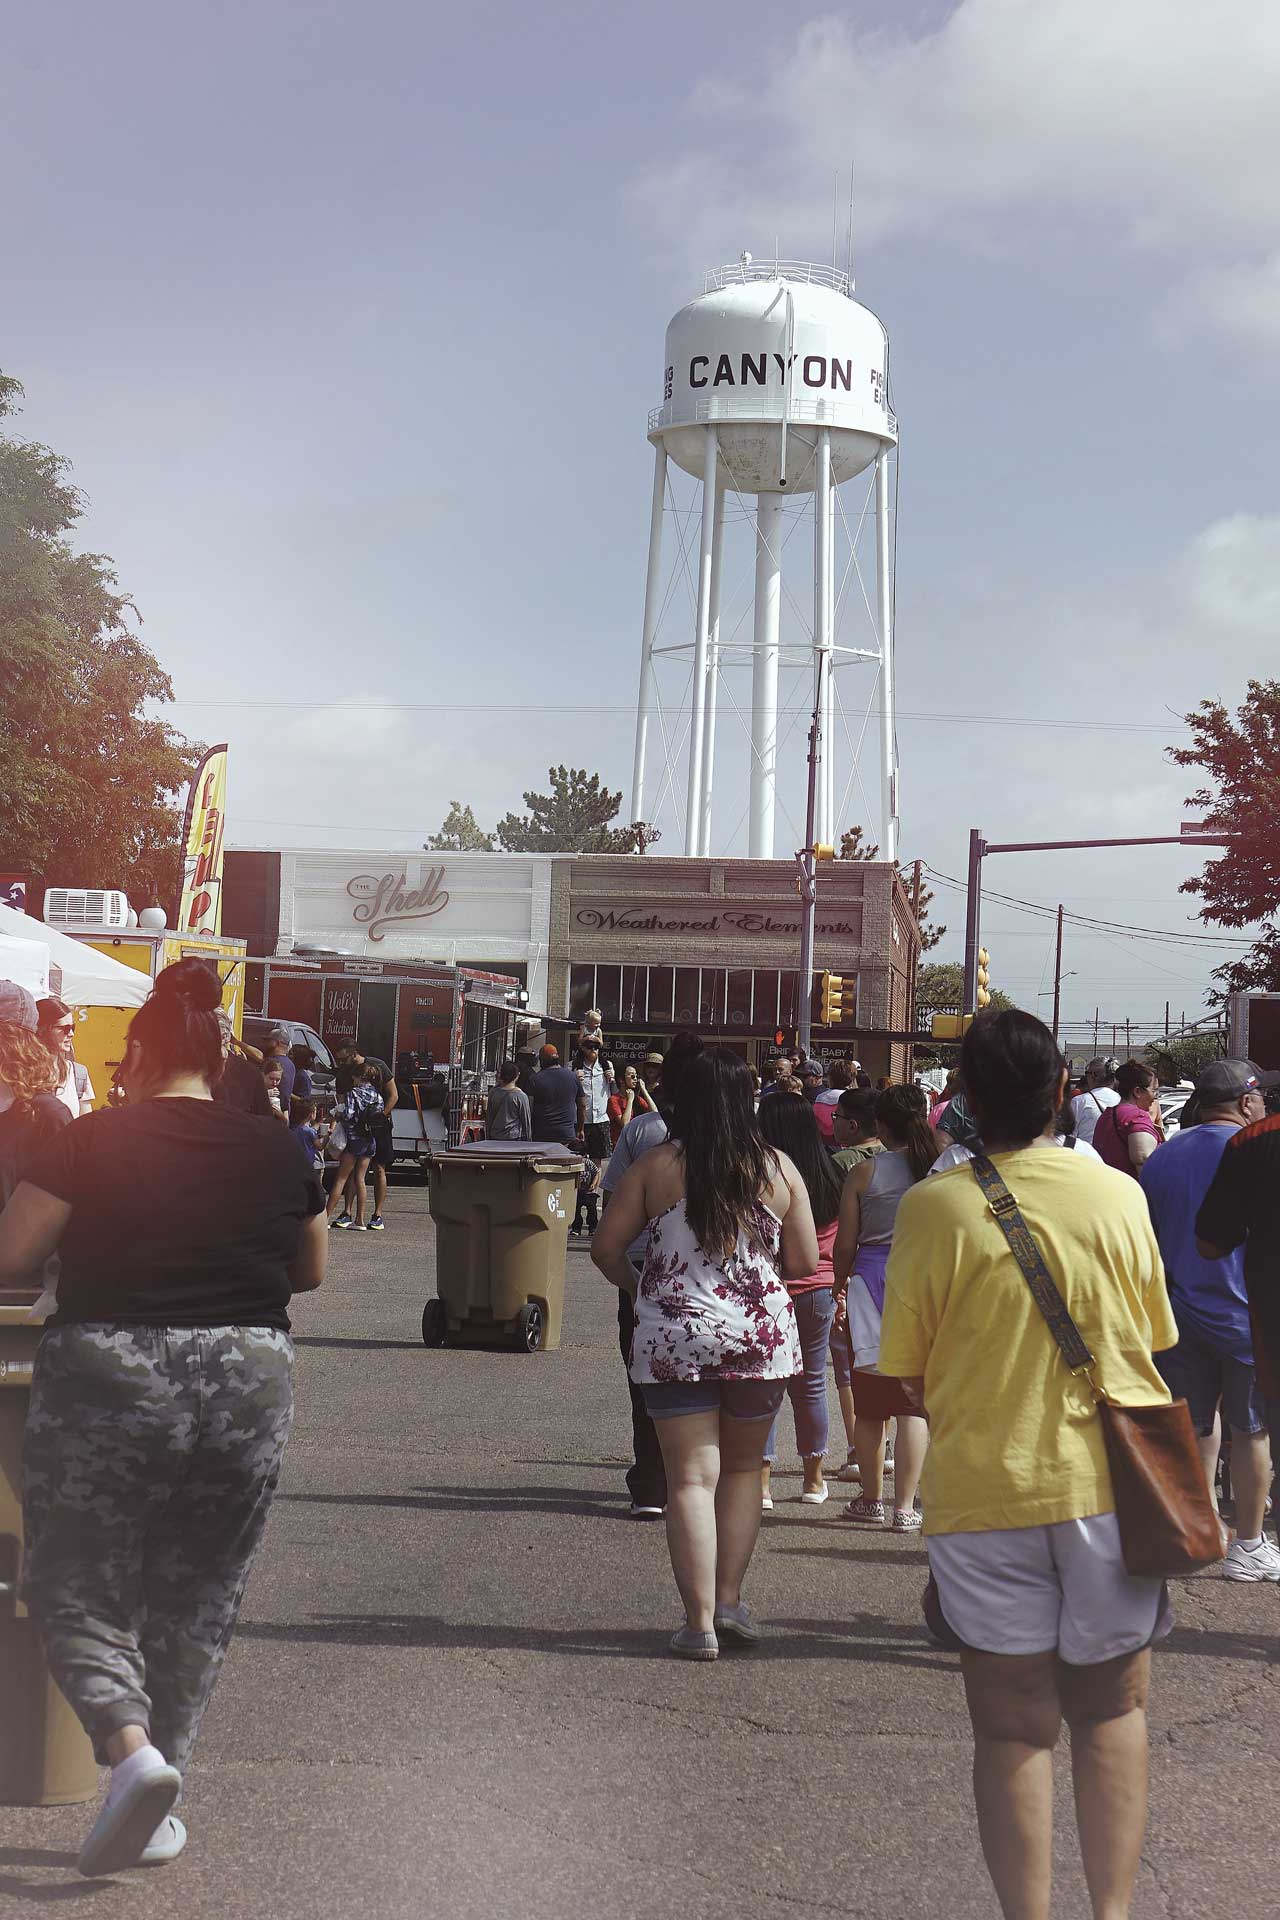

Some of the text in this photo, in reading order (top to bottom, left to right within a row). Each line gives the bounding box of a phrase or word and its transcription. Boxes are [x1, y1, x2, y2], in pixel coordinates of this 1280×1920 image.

[690, 353, 852, 391] CANYON
[347, 865, 449, 942] Shell
[577, 908, 854, 934] Weathered Elemnts
[325, 1019, 354, 1035] Kitchen
